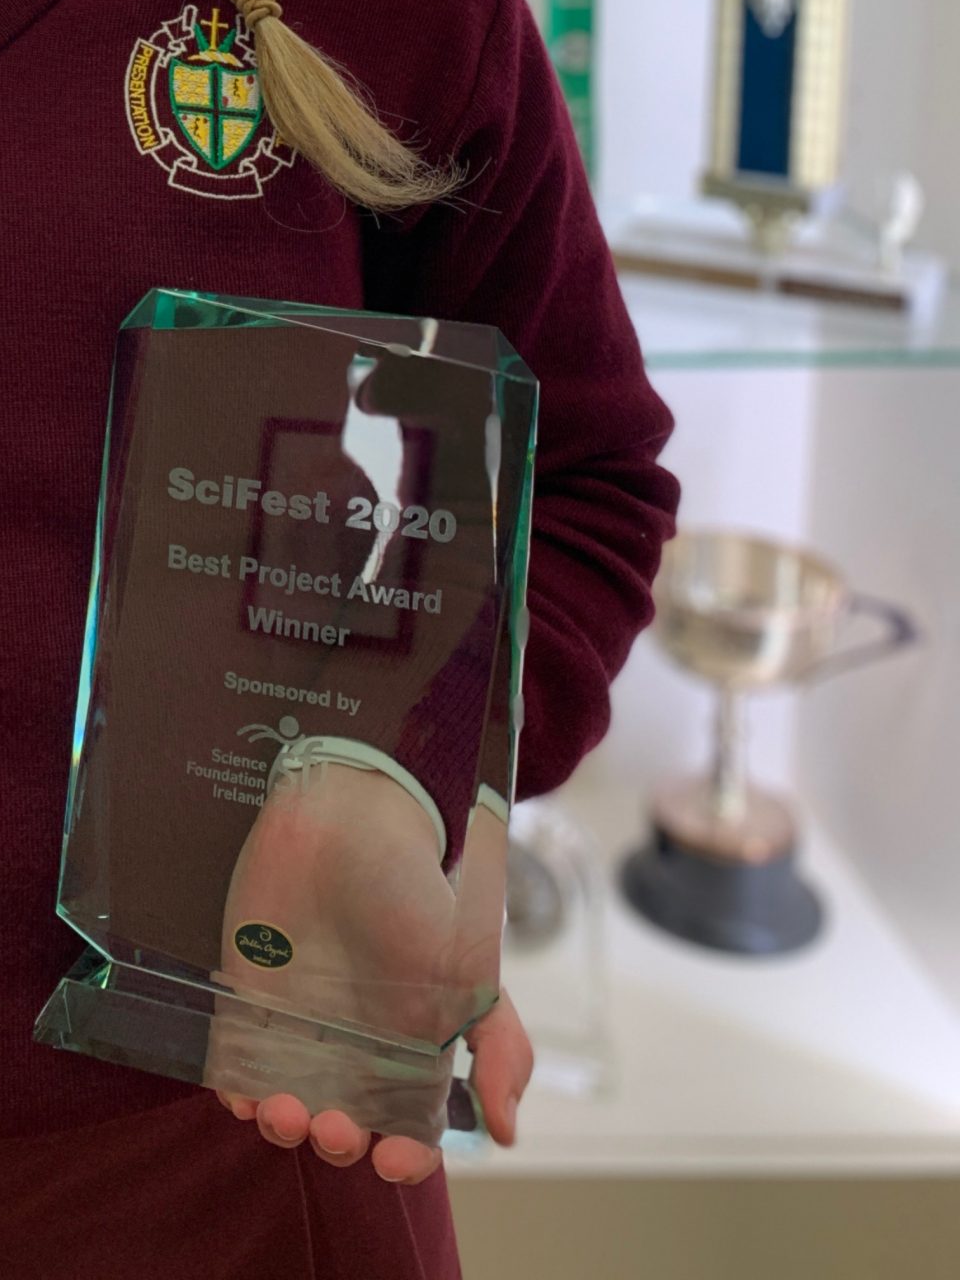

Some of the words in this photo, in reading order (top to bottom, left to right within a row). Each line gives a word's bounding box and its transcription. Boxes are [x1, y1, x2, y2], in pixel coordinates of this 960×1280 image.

[129, 42, 158, 149] PRESENTATION
[167, 467, 331, 524] SciFest
[345, 496, 457, 543] 2020
[167, 544, 231, 578] Best
[239, 556, 342, 598] Project
[346, 576, 443, 614] Award
[248, 605, 351, 647] Winner
[223, 671, 331, 708] Sponsored
[336, 692, 362, 716] by
[186, 760, 267, 791] Foundation
[211, 748, 267, 772] Science
[213, 784, 265, 808] Ireland
